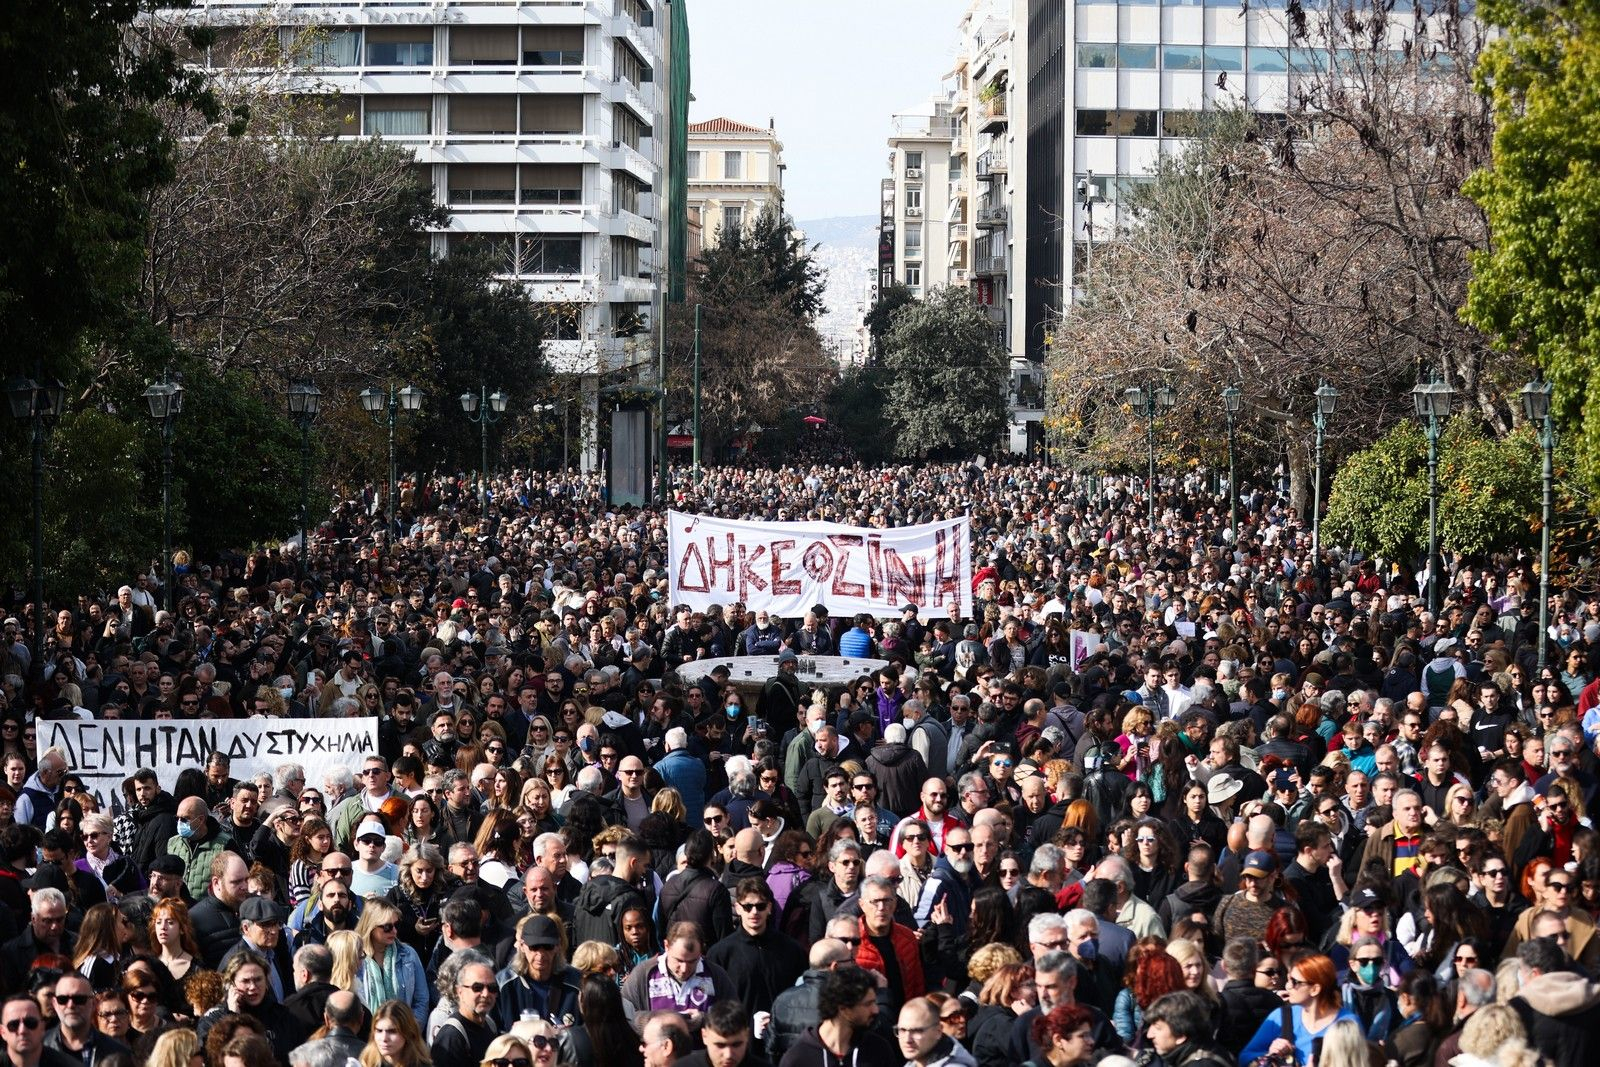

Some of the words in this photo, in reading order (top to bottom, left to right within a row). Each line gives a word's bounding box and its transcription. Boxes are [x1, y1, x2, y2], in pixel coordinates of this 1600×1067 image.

[50, 722, 125, 770] ΔΕΝ
[135, 725, 217, 768] ΗΤΑΝ
[228, 729, 374, 759] ΔΥΣΤΥΧΗΜΑ
